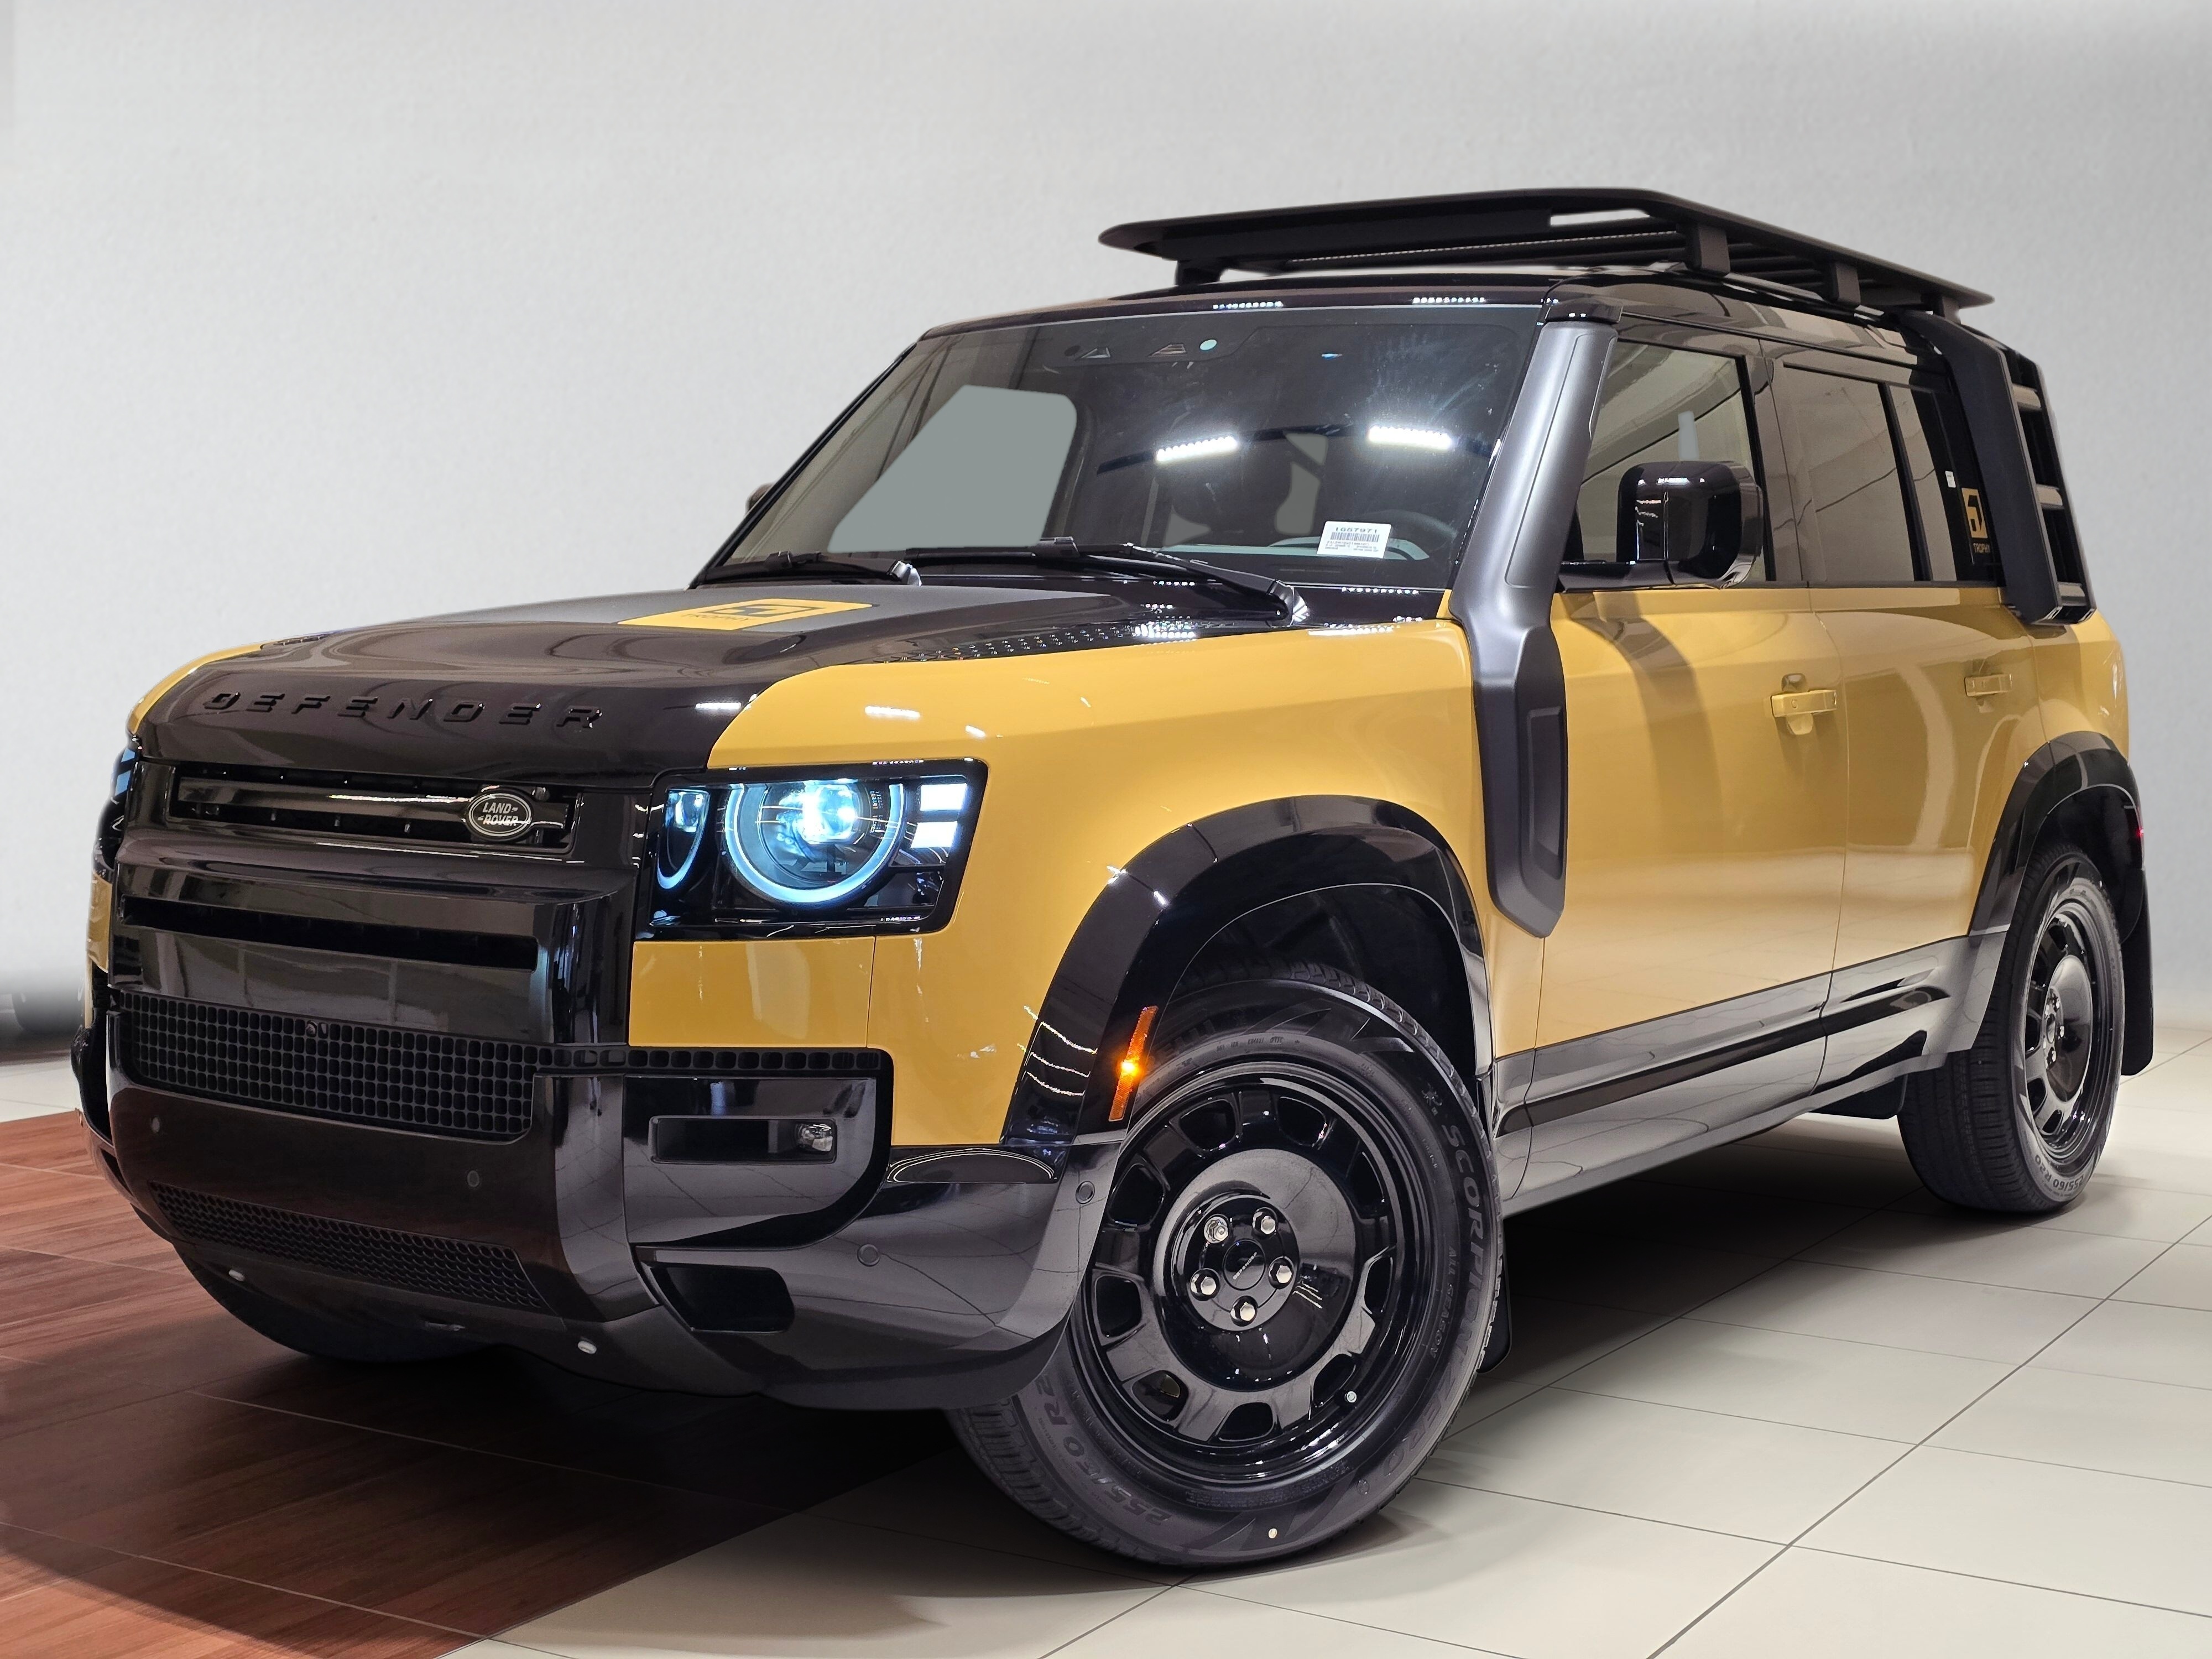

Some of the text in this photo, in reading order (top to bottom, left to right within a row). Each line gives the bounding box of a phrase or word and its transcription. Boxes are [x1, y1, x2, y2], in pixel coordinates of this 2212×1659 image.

[204, 692, 603, 729] DEFENDER
[483, 815, 519, 826] ROVER
[1441, 1123, 1484, 1355] SCORPION
[1430, 1245, 1458, 1360] ALL SEASON
